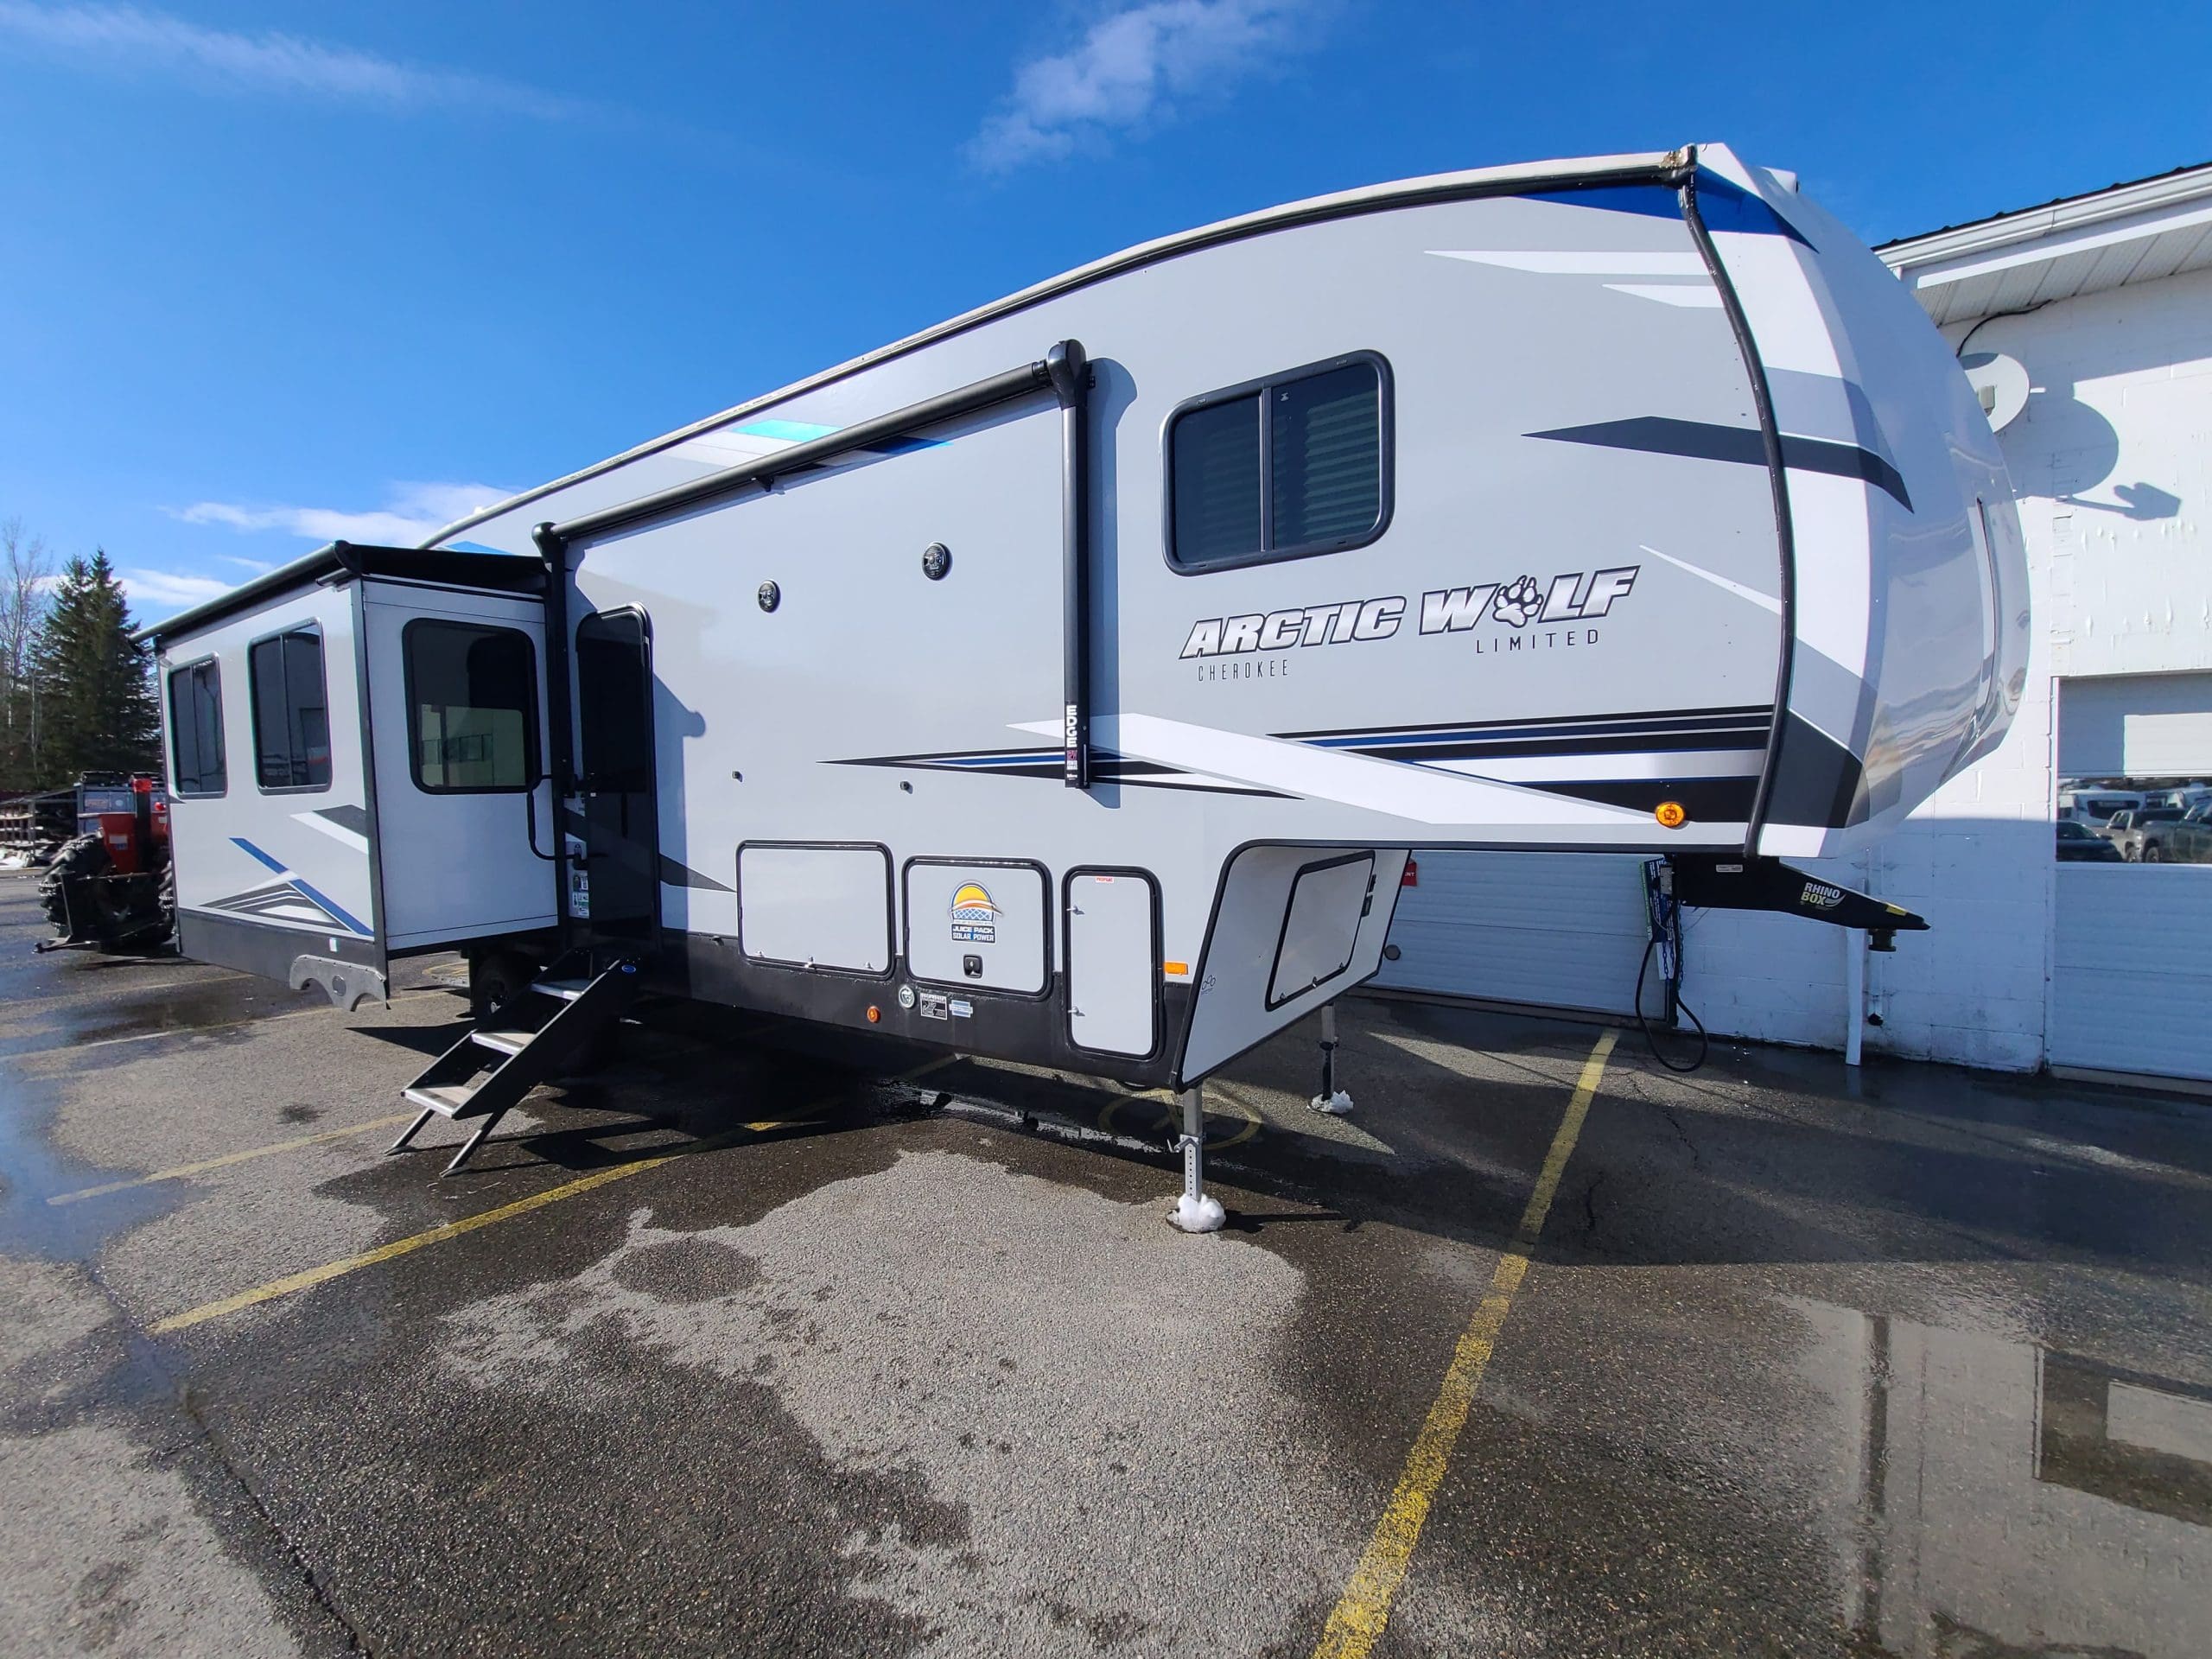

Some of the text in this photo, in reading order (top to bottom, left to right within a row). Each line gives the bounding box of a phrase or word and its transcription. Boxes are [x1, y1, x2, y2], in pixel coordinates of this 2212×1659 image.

[1179, 596, 1406, 659] ARCTIC
[1476, 629, 1599, 653] LIMITED
[1198, 659, 1288, 682] CHEROKEE
[1065, 704, 1078, 748] EDGE
[1801, 891, 1827, 906] BOX
[1804, 881, 1840, 899] RHINO
